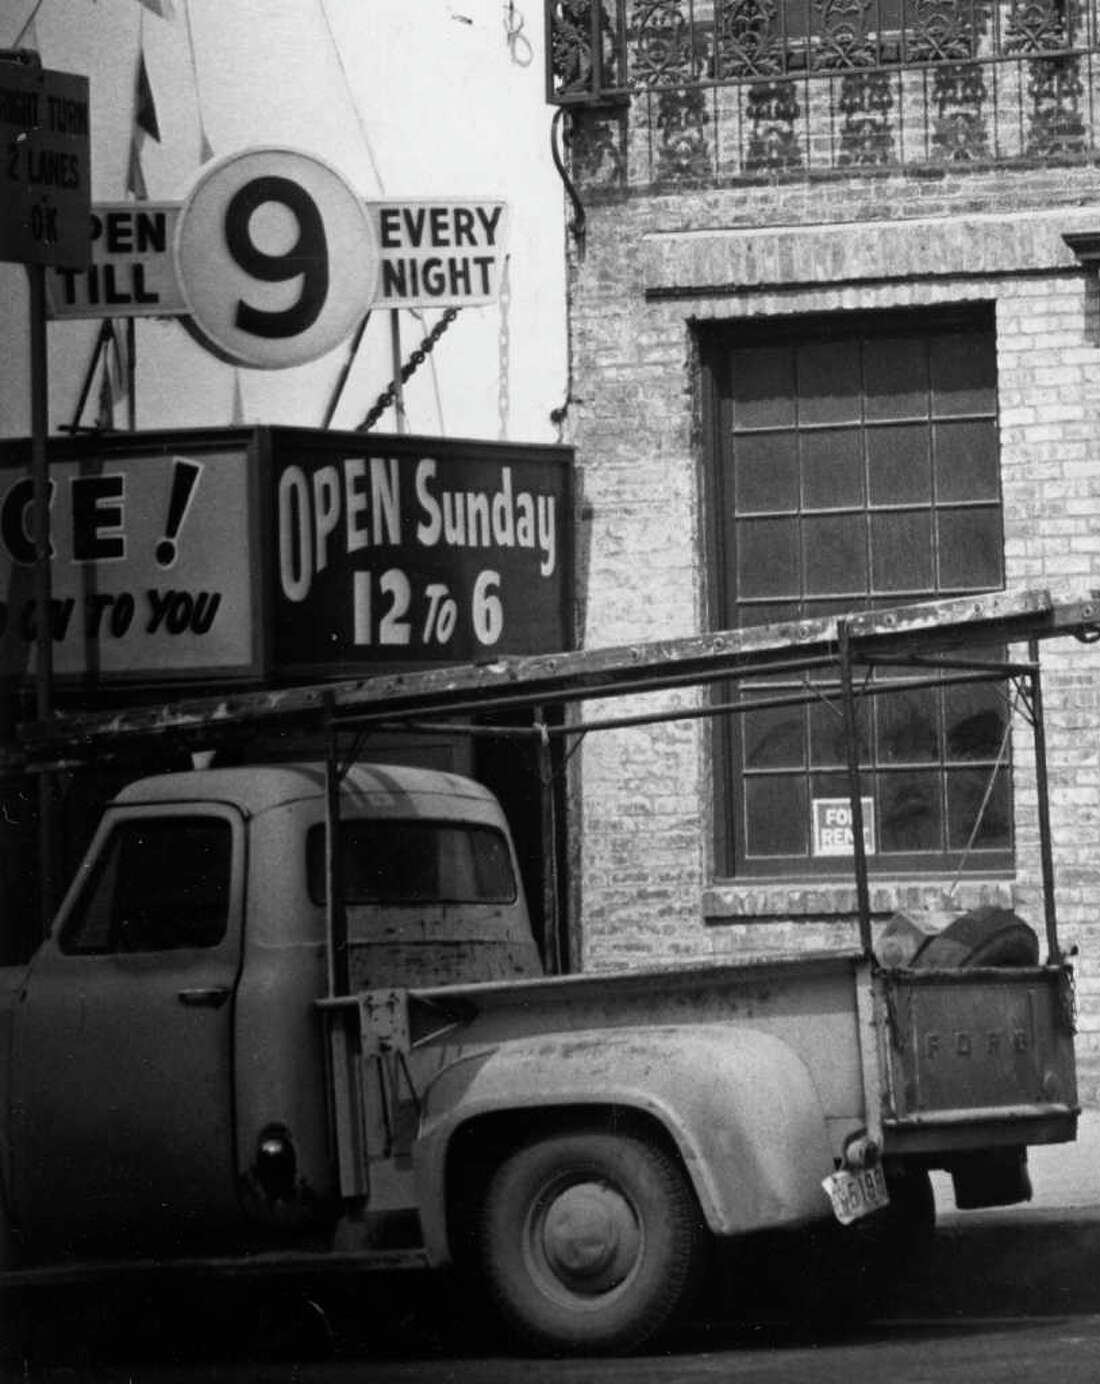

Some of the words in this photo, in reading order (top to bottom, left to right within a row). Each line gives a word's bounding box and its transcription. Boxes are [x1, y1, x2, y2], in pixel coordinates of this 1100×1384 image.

[28, 149, 80, 189] LANES
[380, 207, 502, 248] EVERY
[225, 176, 329, 339] 9
[382, 257, 495, 297] NIGHT
[56, 264, 159, 304] TILL
[279, 457, 400, 602] OPEN
[415, 458, 556, 577] Sunday
[86, 592, 135, 638] TO
[147, 589, 222, 635] YOU
[353, 568, 411, 645] 12
[472, 569, 503, 646] 6
[826, 808, 853, 825] FO
